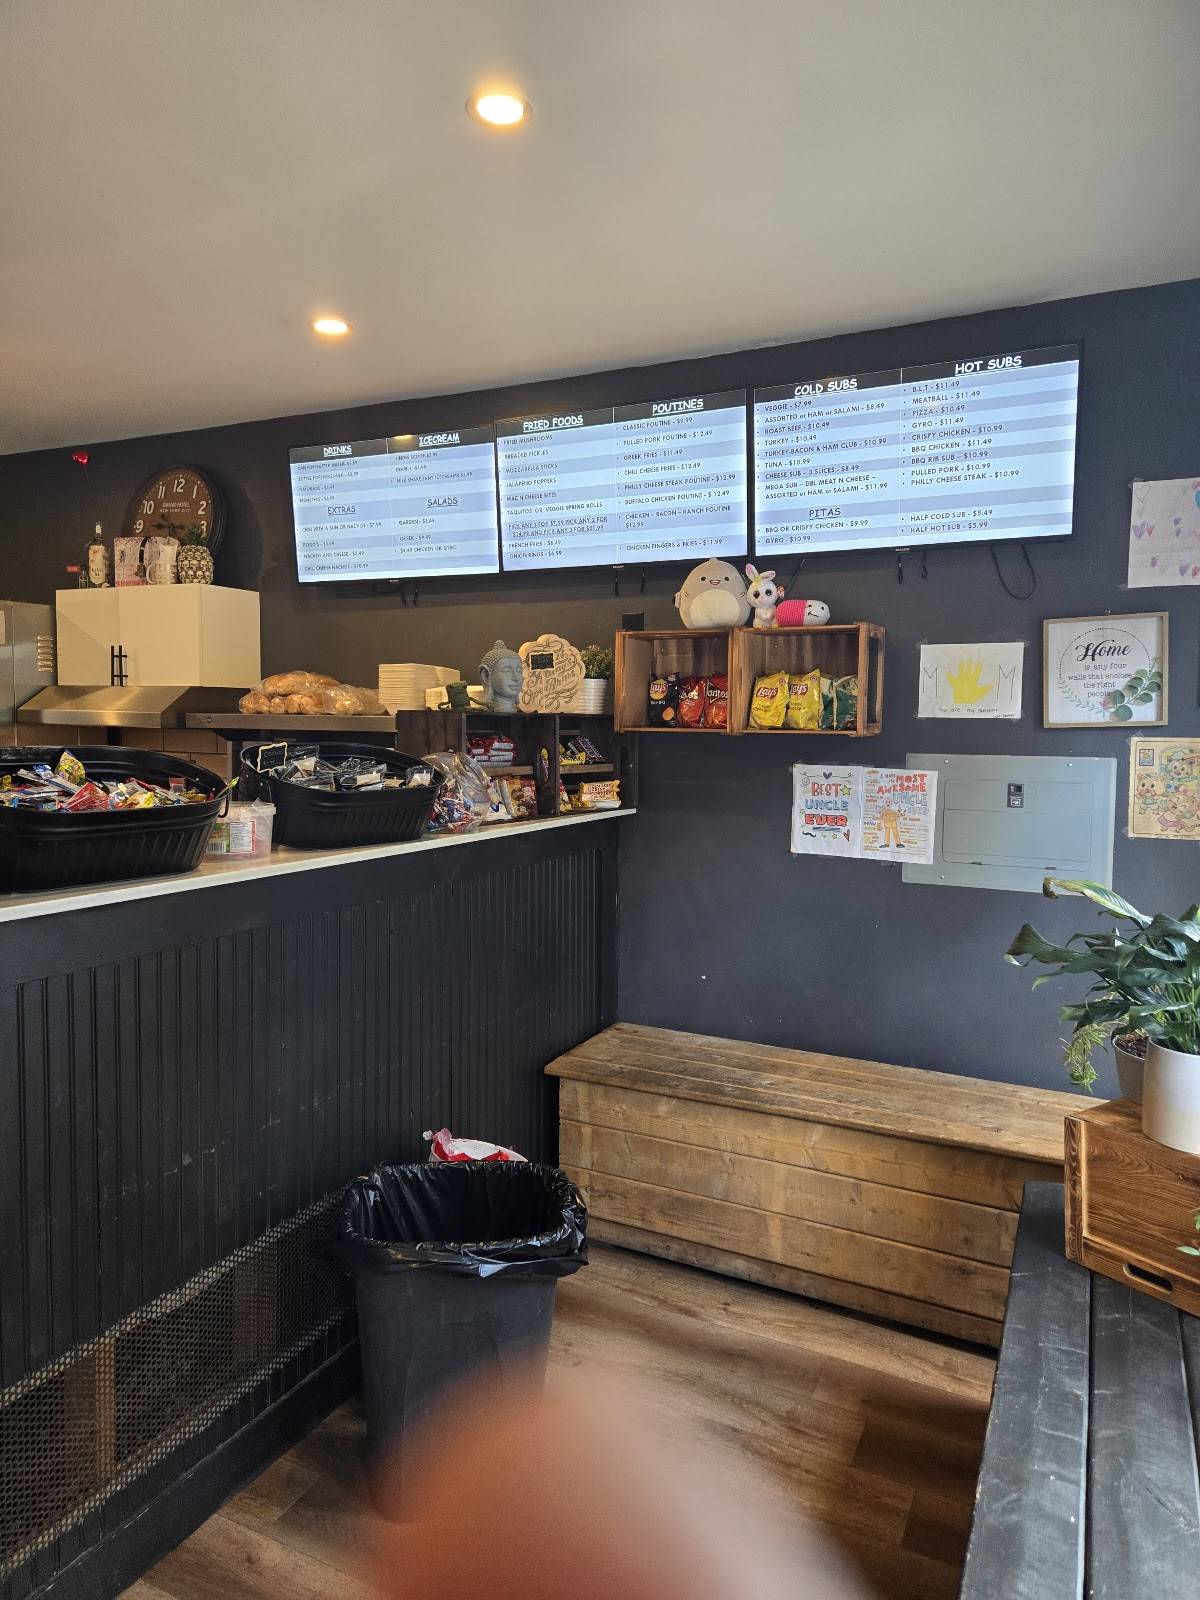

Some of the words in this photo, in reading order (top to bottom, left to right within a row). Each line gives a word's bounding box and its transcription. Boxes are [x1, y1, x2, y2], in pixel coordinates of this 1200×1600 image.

[956, 361, 983, 373] HOT
[988, 356, 1022, 369] SUBS
[795, 386, 823, 395] COLD
[828, 379, 857, 390] SUBS
[936, 381, 960, 389] $11.49
[913, 395, 948, 404] MEATBALL
[956, 390, 980, 399] $11.49
[652, 399, 703, 414] POUTINES
[765, 404, 788, 412] VEGGIE
[941, 405, 965, 413] $10.49
[765, 414, 798, 423] ASSORTED
[833, 406, 860, 414] SALAMI
[524, 421, 549, 431] FRIED
[553, 415, 583, 427] FOODS
[647, 420, 671, 428] POUTINE
[940, 417, 964, 425] $11.49
[693, 430, 712, 438] $12.49
[912, 432, 936, 440] CRISPY
[939, 428, 971, 438] CHICKEN
[978, 424, 1003, 433] $10.99
[419, 433, 460, 445] ICECREAM
[518, 435, 552, 444] MUSHROOMS
[929, 442, 960, 451] CHICKEN
[968, 438, 992, 446] $11.49
[323, 445, 352, 456] DRINKS
[505, 466, 539, 474] MOZZARELLA
[939, 466, 959, 474] PORK
[966, 463, 990, 471] $10.99
[964, 473, 986, 481] STEAK
[173, 479, 185, 493] 12
[158, 485, 166, 499] 11
[193, 485, 197, 499] 1
[142, 500, 154, 514] 10
[198, 501, 206, 514] 2
[427, 497, 458, 507] SALADS
[328, 506, 356, 514] EXTRAS
[809, 508, 841, 518] PITAS
[136, 520, 144, 533] 9
[201, 521, 207, 535] 3
[815, 521, 844, 529] CHICKEN
[911, 525, 928, 533] HALF
[1076, 640, 1131, 662] Home
[1093, 664, 1108, 672] any
[758, 688, 778, 698] Lay's
[790, 684, 808, 695] Lay's
[896, 774, 927, 783] MOST
[812, 782, 841, 798] BEST
[877, 783, 926, 794] AWESOME
[805, 799, 848, 811] UNCLE
[805, 814, 847, 827] EVER
